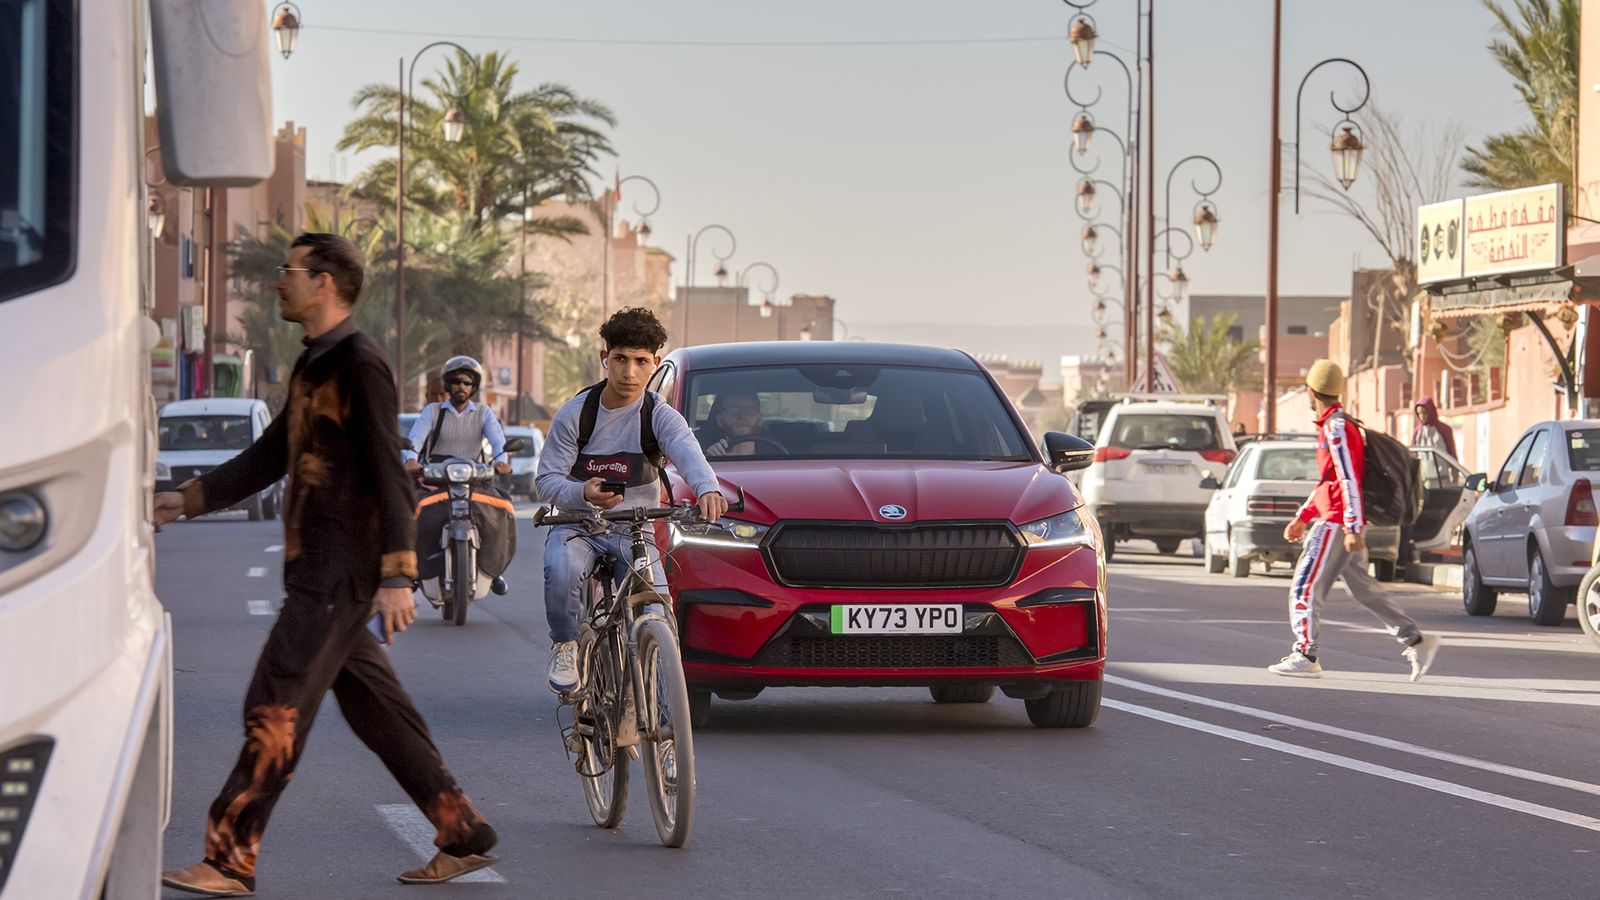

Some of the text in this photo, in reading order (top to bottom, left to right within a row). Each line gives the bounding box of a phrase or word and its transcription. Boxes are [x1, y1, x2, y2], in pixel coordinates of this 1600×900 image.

[586, 459, 628, 474] Supreme
[848, 607, 958, 629] KY73 YPO
